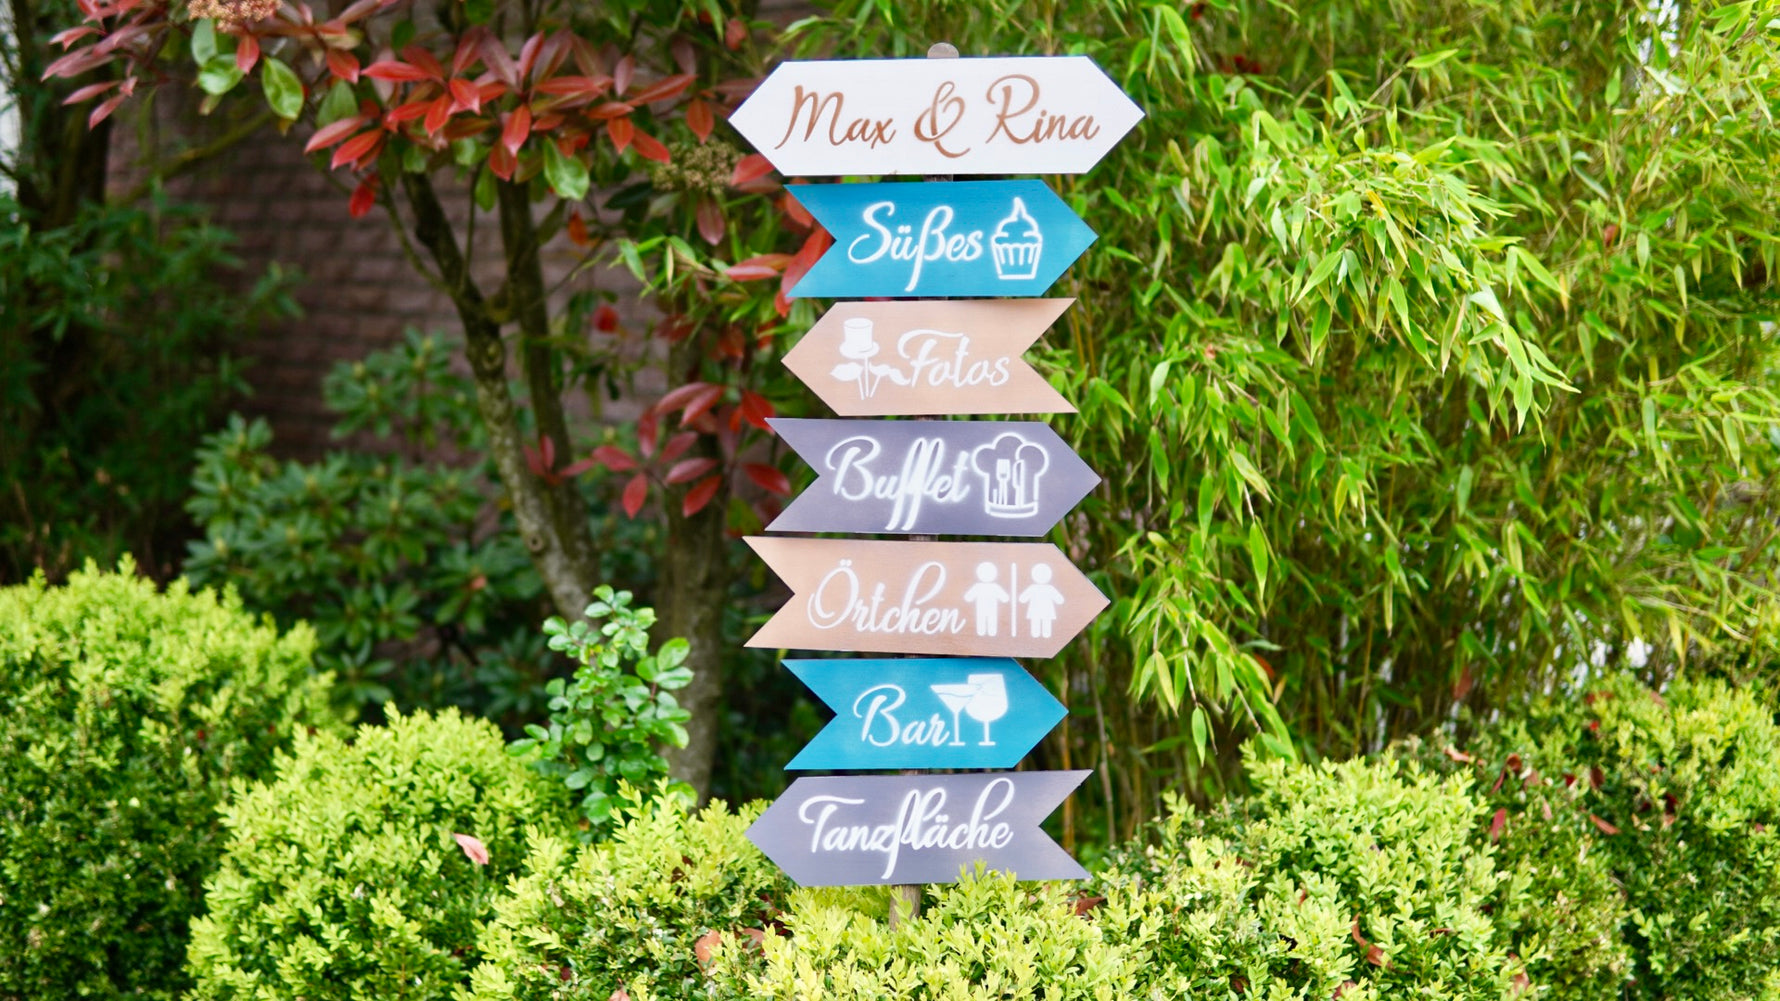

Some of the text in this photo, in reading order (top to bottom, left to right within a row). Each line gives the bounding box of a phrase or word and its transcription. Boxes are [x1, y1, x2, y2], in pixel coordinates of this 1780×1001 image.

[774, 73, 1101, 158] Max & Rina
[847, 201, 984, 292] Süßes
[897, 328, 1011, 388] Fotos
[825, 435, 971, 531] Buffet
[807, 558, 967, 635] Örtchen
[853, 684, 951, 747] Bar
[798, 777, 1016, 880] Tanzfläche
